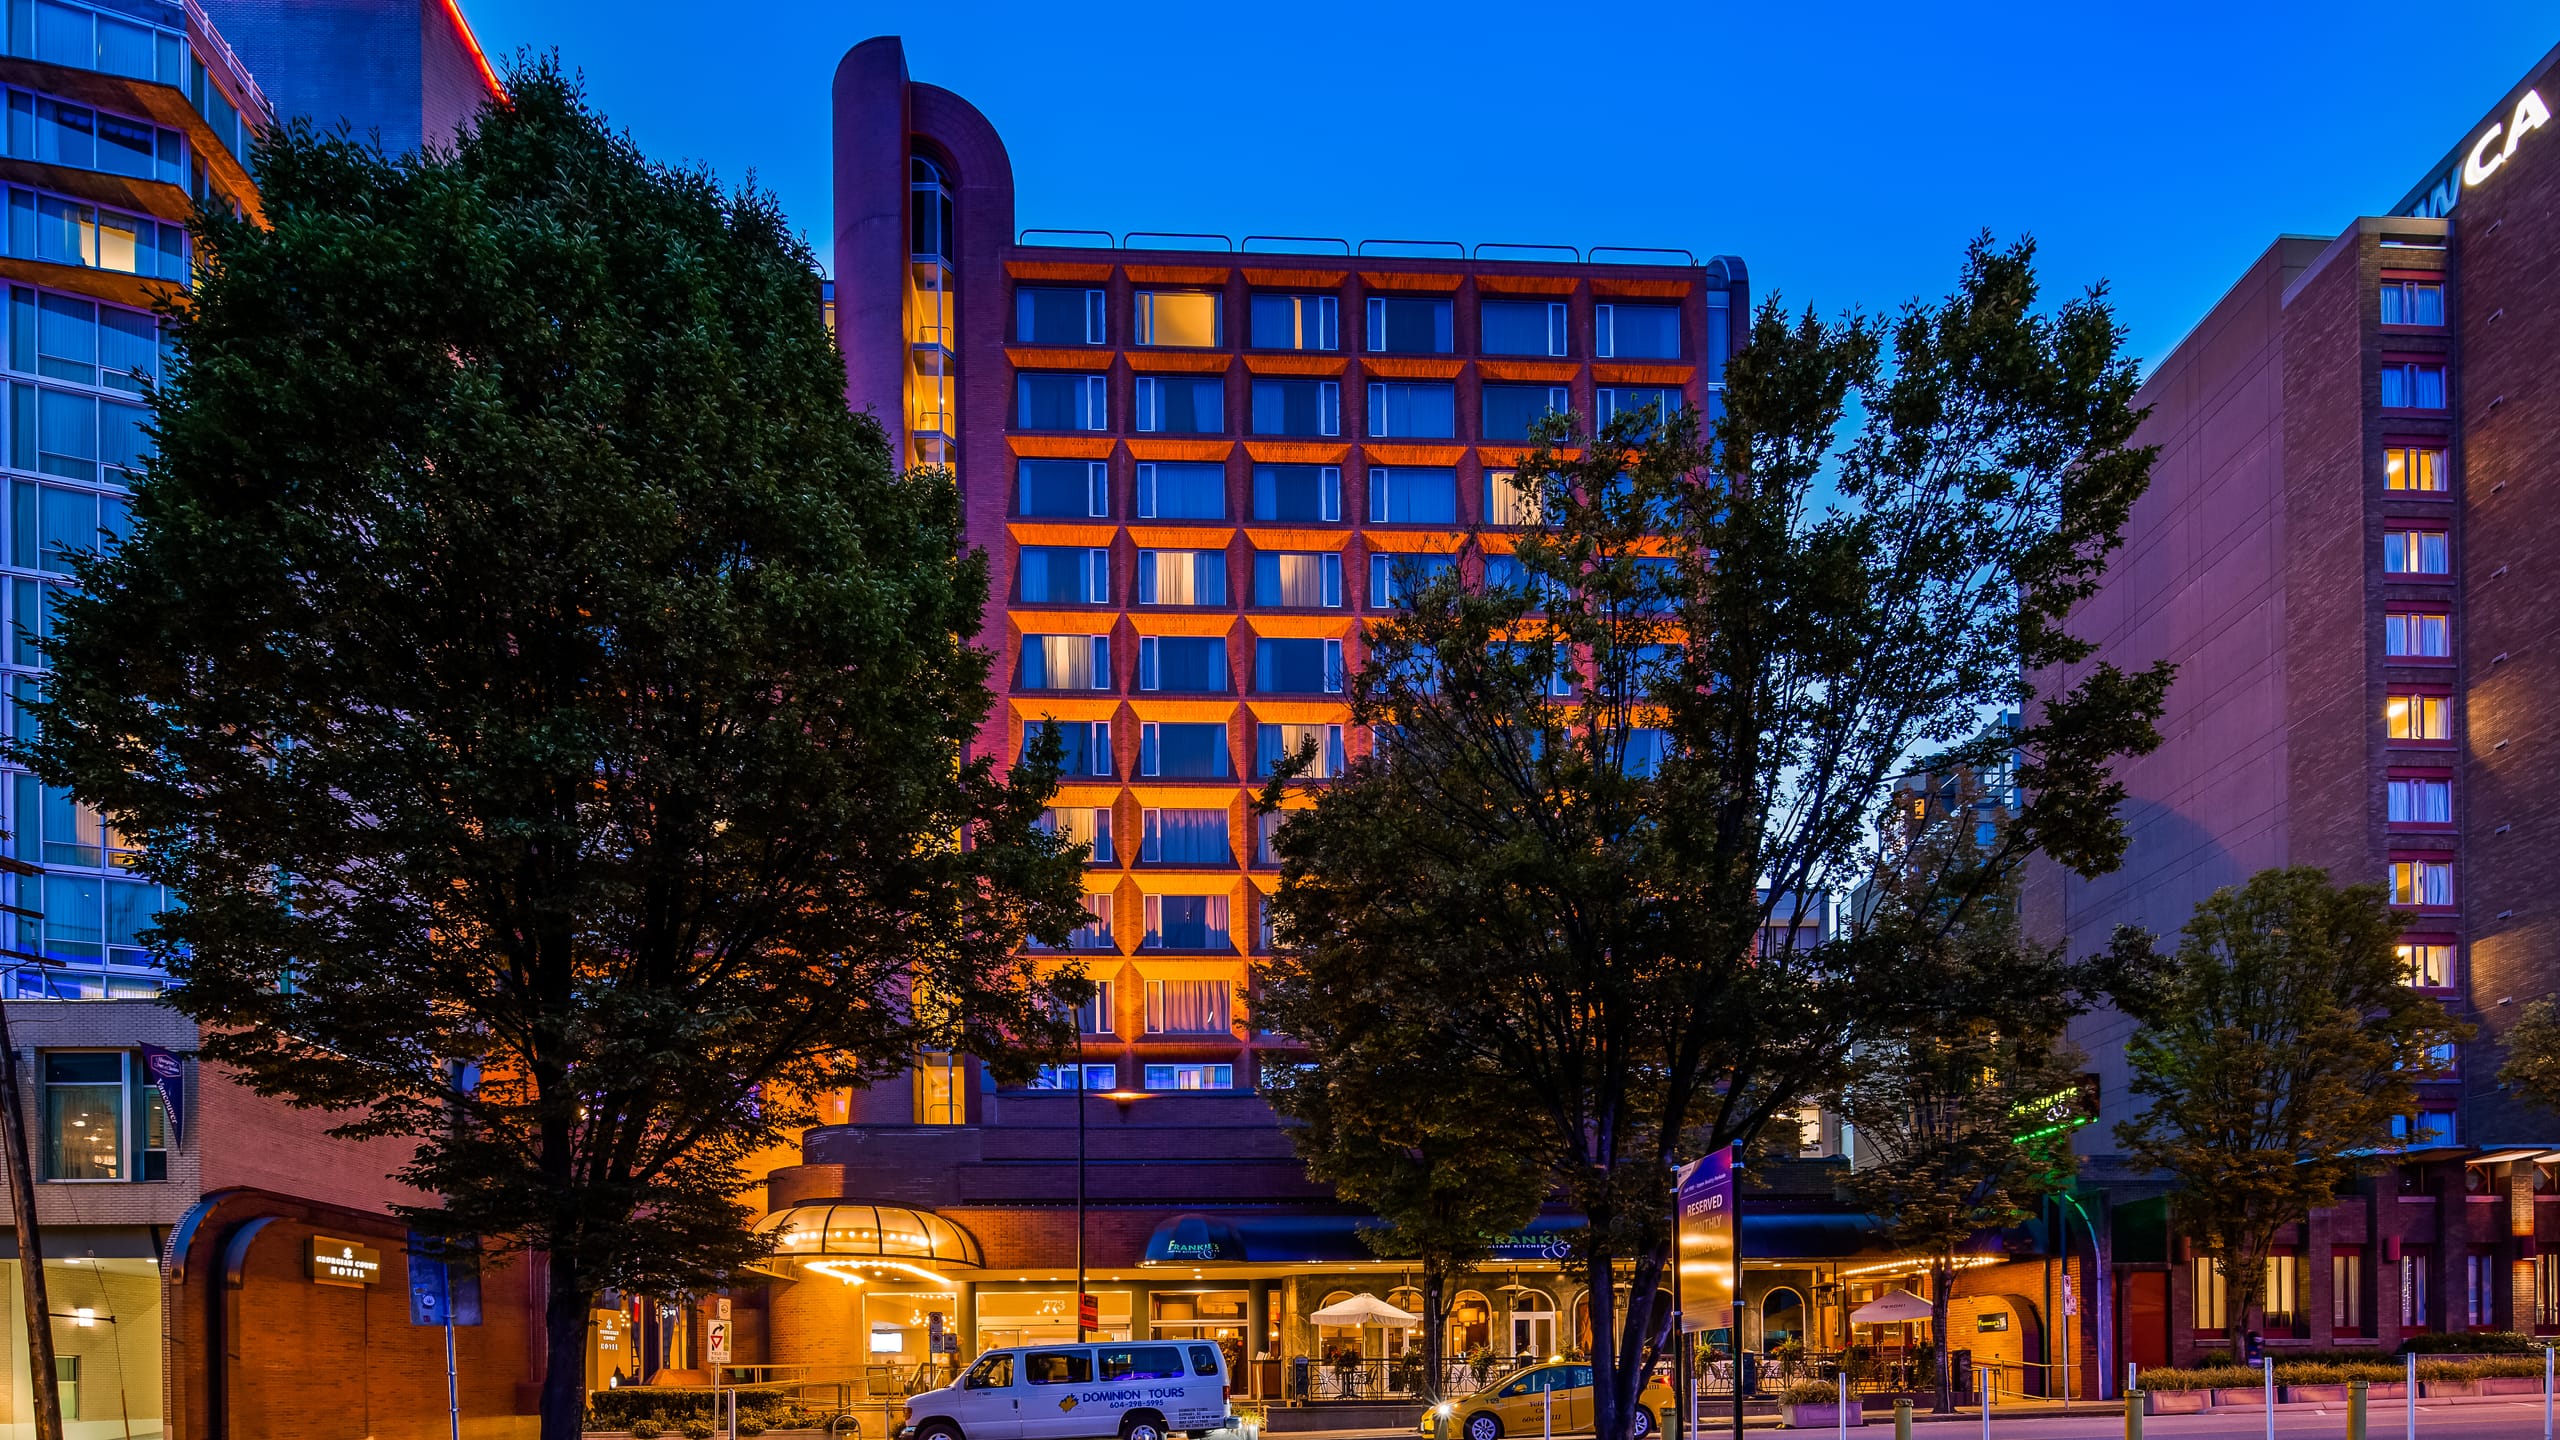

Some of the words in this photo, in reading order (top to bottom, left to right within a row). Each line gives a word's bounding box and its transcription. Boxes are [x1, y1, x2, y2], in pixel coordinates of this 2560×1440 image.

[2406, 88, 2551, 218] WCA
[156, 1078, 178, 1124] Vancouver
[1687, 1194, 1723, 1217] RESERVED
[1688, 1214, 1722, 1232] MONTHLY
[315, 1255, 354, 1267] GEORGIAN
[330, 1265, 365, 1278] HOTEL
[1042, 1299, 1066, 1313] 773
[1082, 1389, 1141, 1402] DOMINION
[1148, 1387, 1185, 1399] TOURS
[1109, 1399, 1164, 1408] 604-298-5995
